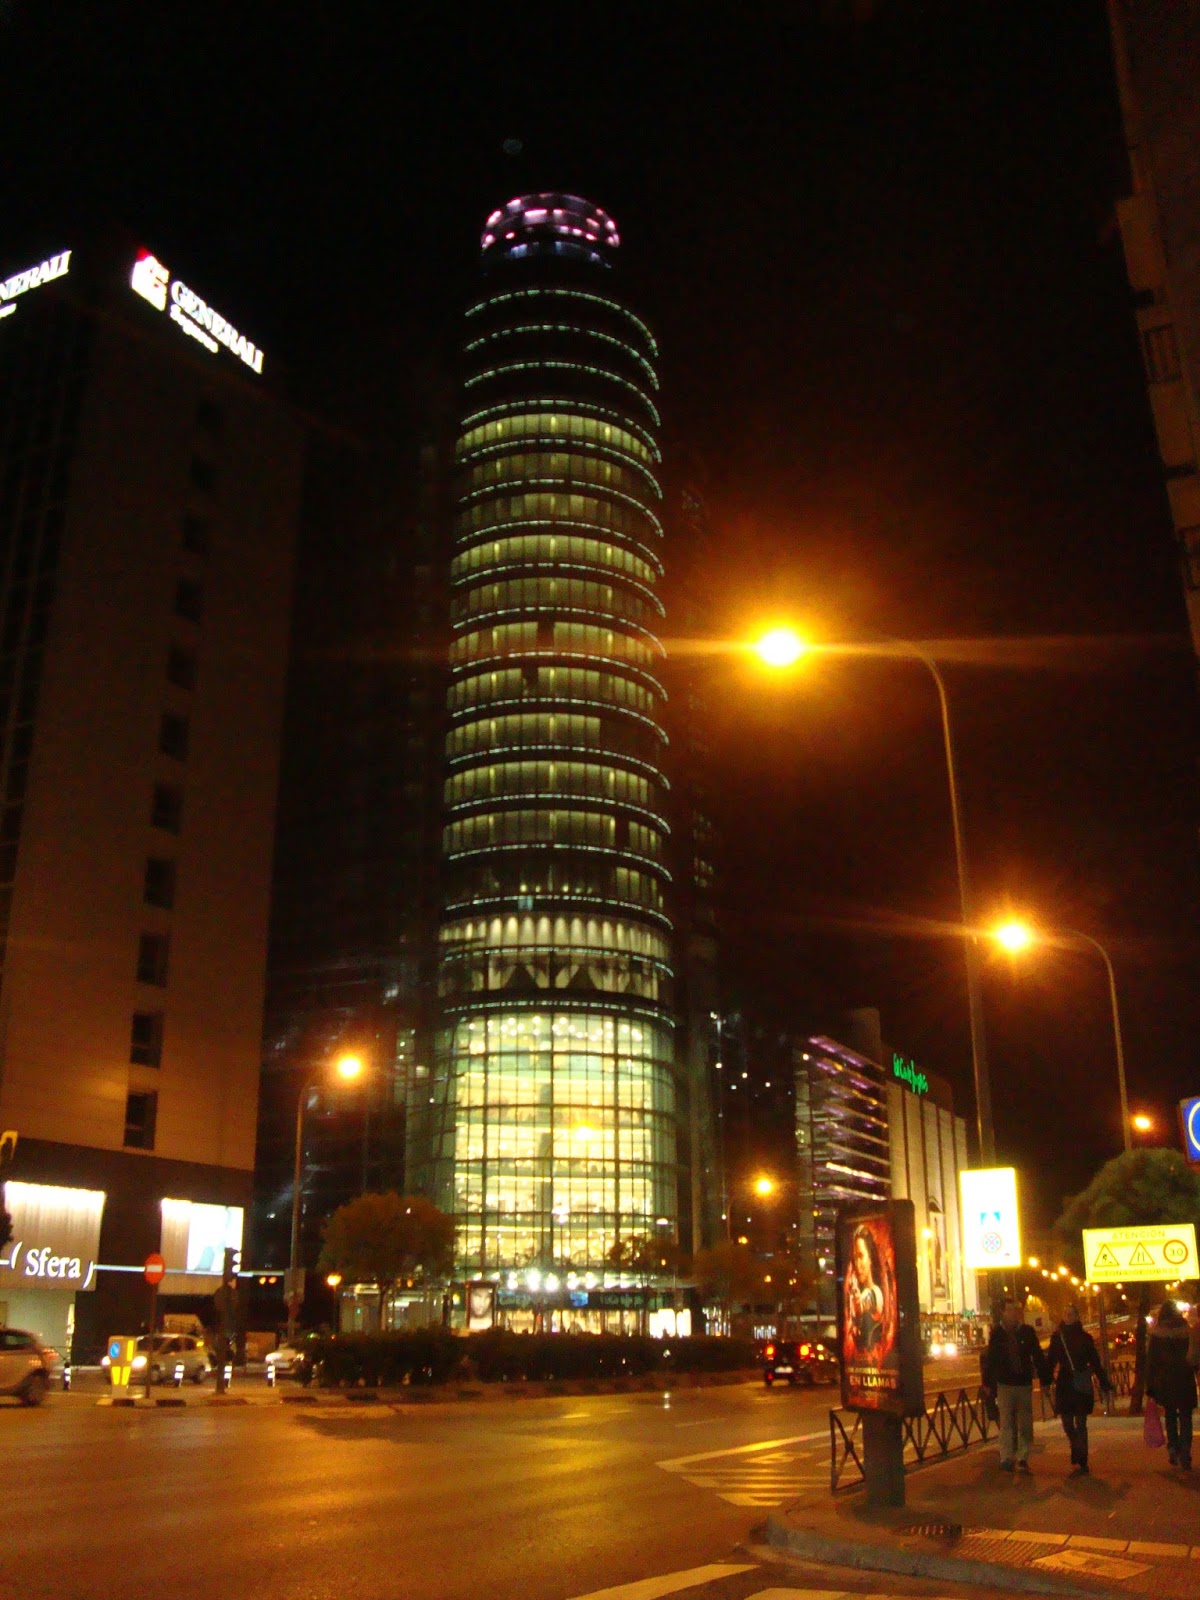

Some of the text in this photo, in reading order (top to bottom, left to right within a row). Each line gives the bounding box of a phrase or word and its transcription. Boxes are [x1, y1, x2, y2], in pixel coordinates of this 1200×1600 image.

[171, 281, 265, 375] GENERALI
[1112, 1228, 1165, 1239] ATENCIÓN
[25, 1247, 81, 1278] Sfera
[1169, 1247, 1184, 1257] 30
